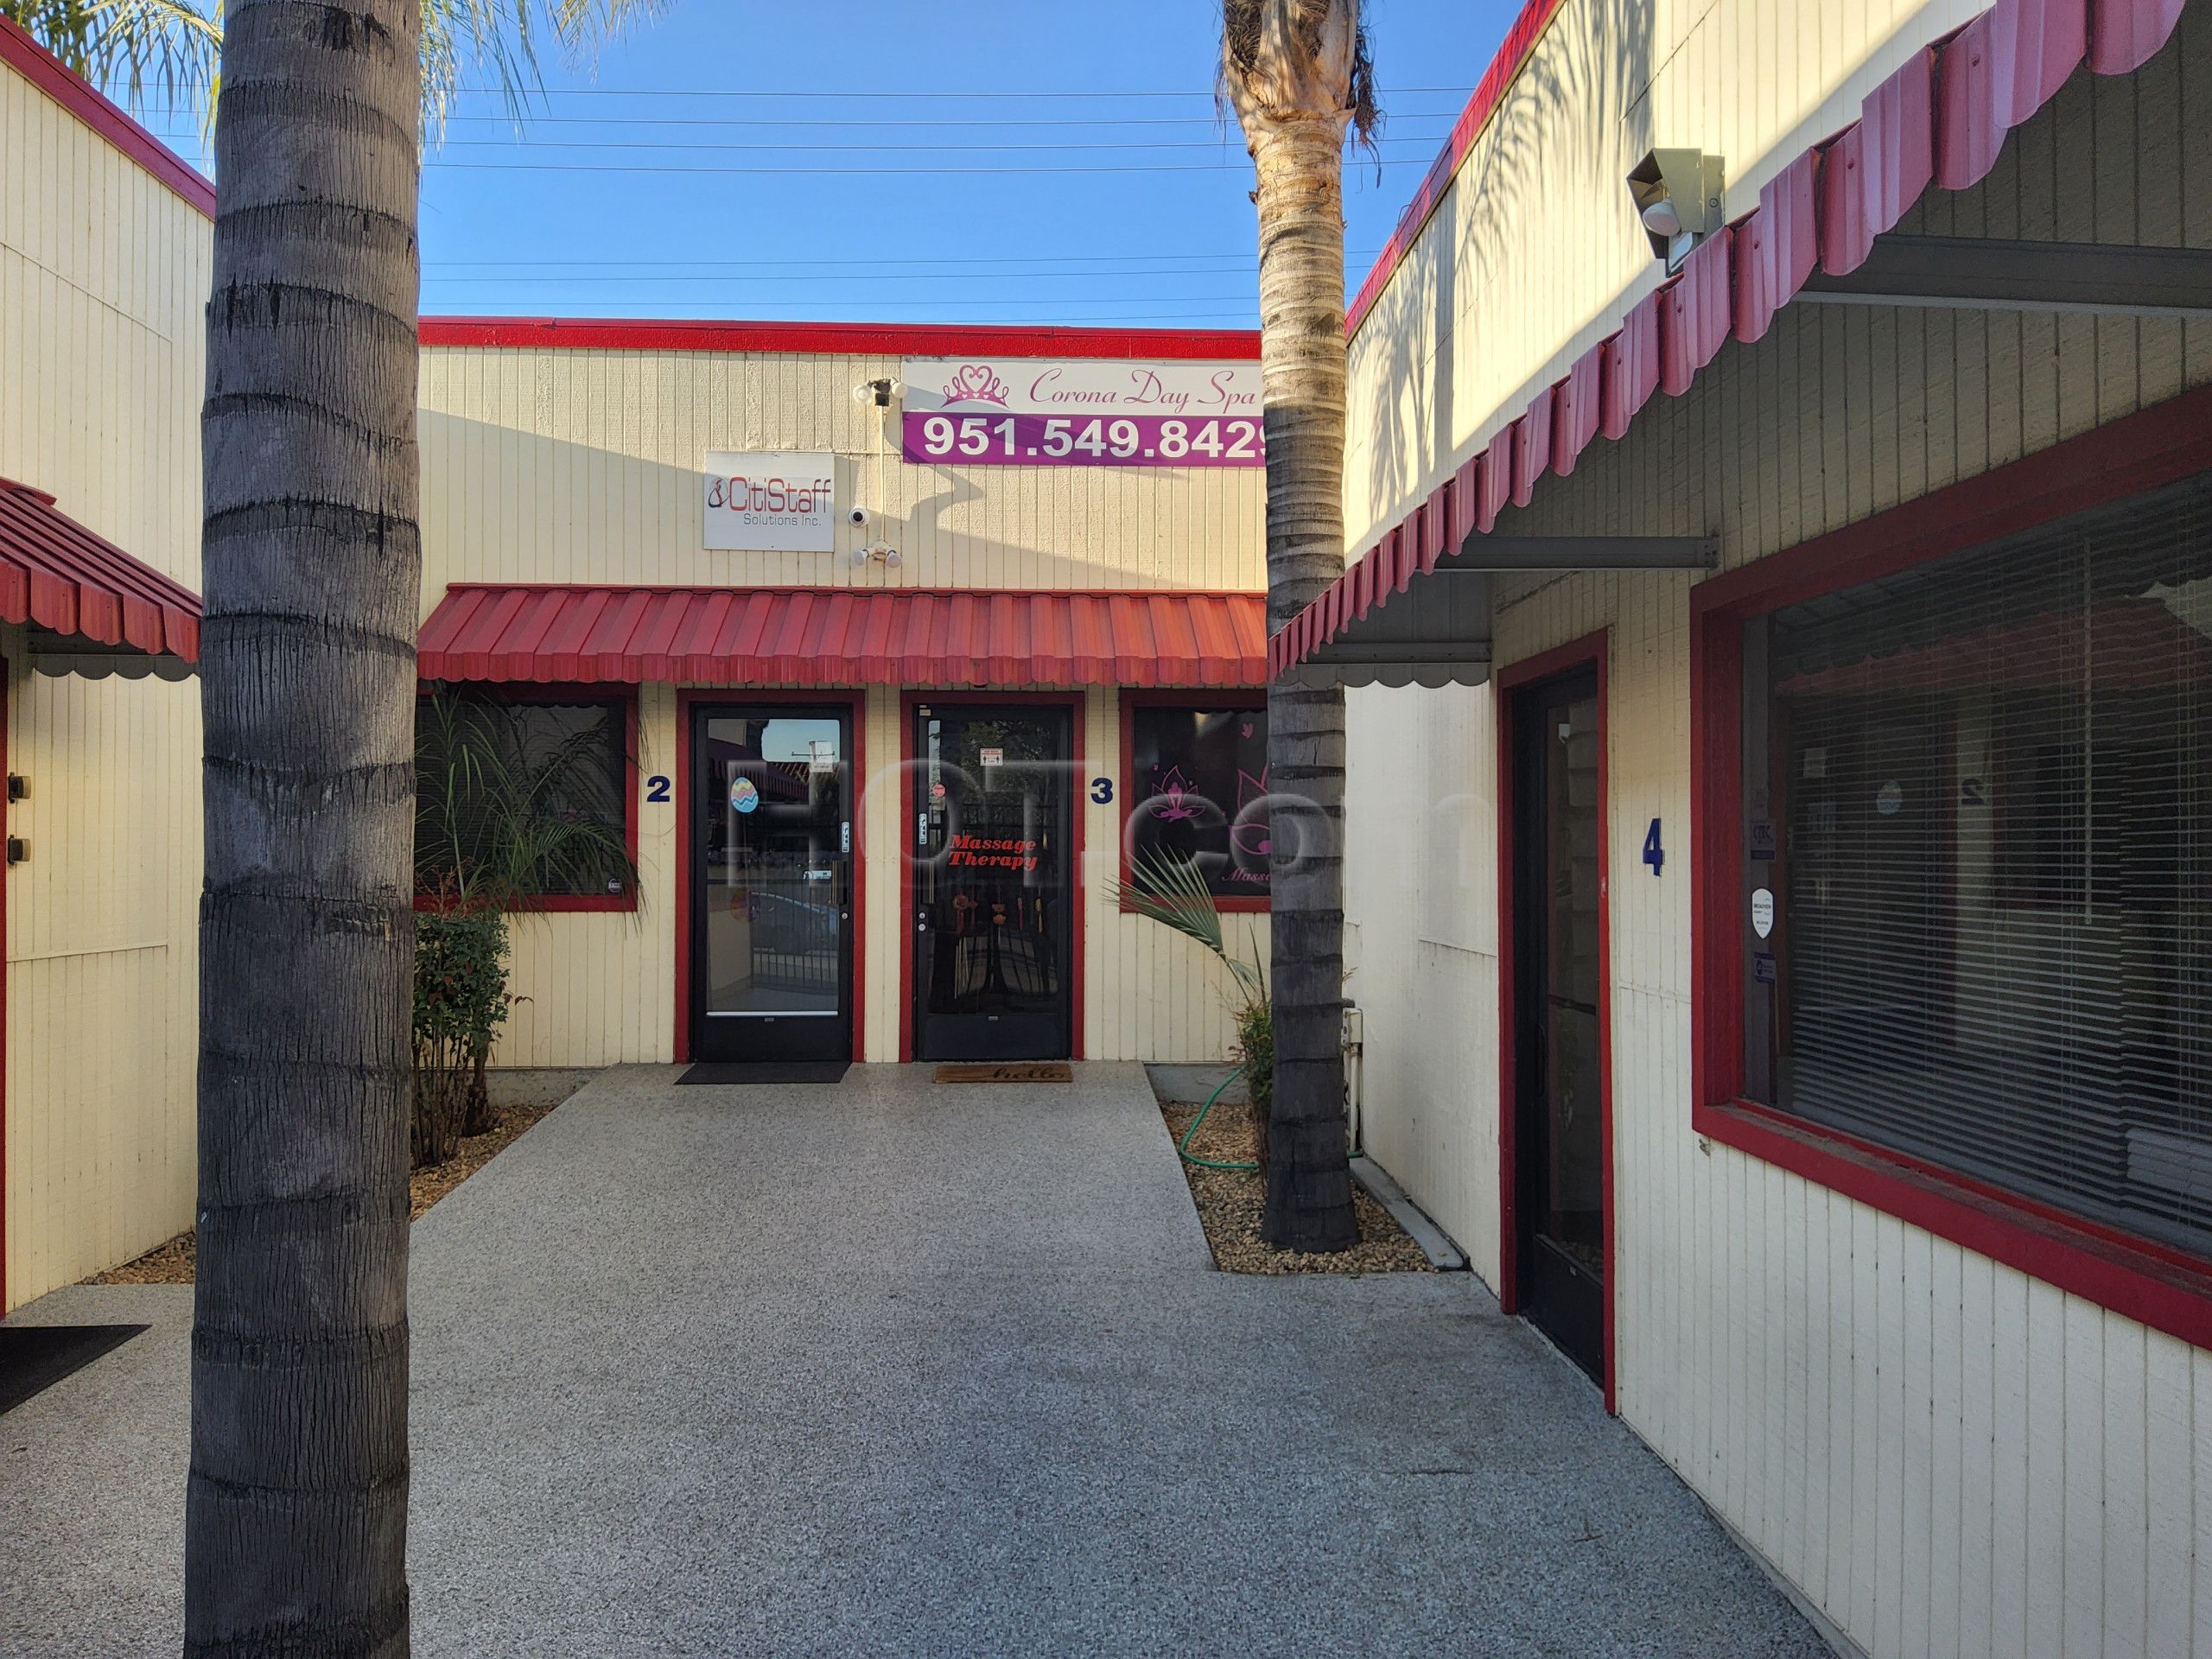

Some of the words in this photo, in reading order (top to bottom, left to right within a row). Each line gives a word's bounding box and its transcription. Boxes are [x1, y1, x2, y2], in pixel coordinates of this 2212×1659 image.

[1030, 368, 1116, 403] Corona
[1123, 370, 1189, 414] Day
[1197, 371, 1255, 414] Spa
[924, 416, 1265, 458] 951.549.842
[729, 477, 830, 513] CitiStaff
[743, 513, 798, 525] Solutions
[802, 514, 822, 526] Inc.
[646, 776, 670, 802] 2
[1091, 777, 1113, 804] 3
[950, 834, 1036, 854] Massage
[1643, 818, 1664, 876] 4
[949, 851, 1037, 871] Therapy
